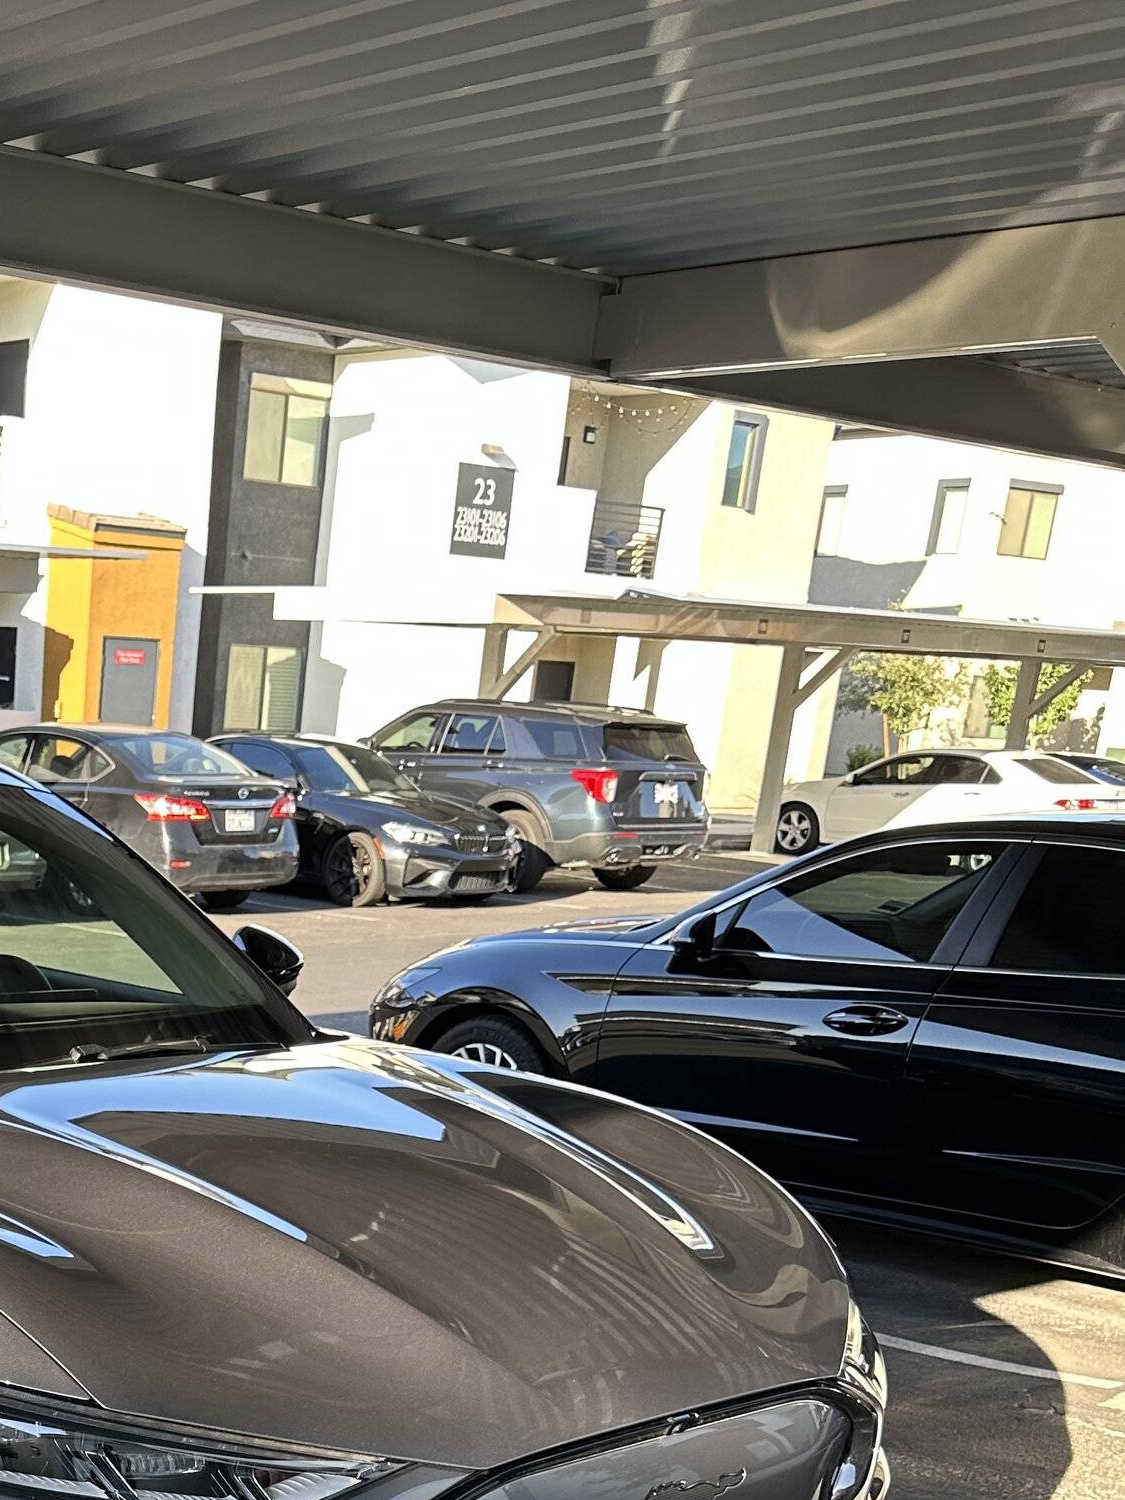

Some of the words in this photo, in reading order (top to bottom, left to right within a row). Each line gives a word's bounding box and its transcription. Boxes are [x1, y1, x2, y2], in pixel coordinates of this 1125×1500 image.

[473, 478, 496, 505] 23
[456, 507, 507, 528] 23101-23106
[453, 526, 506, 546] 23201-23206
